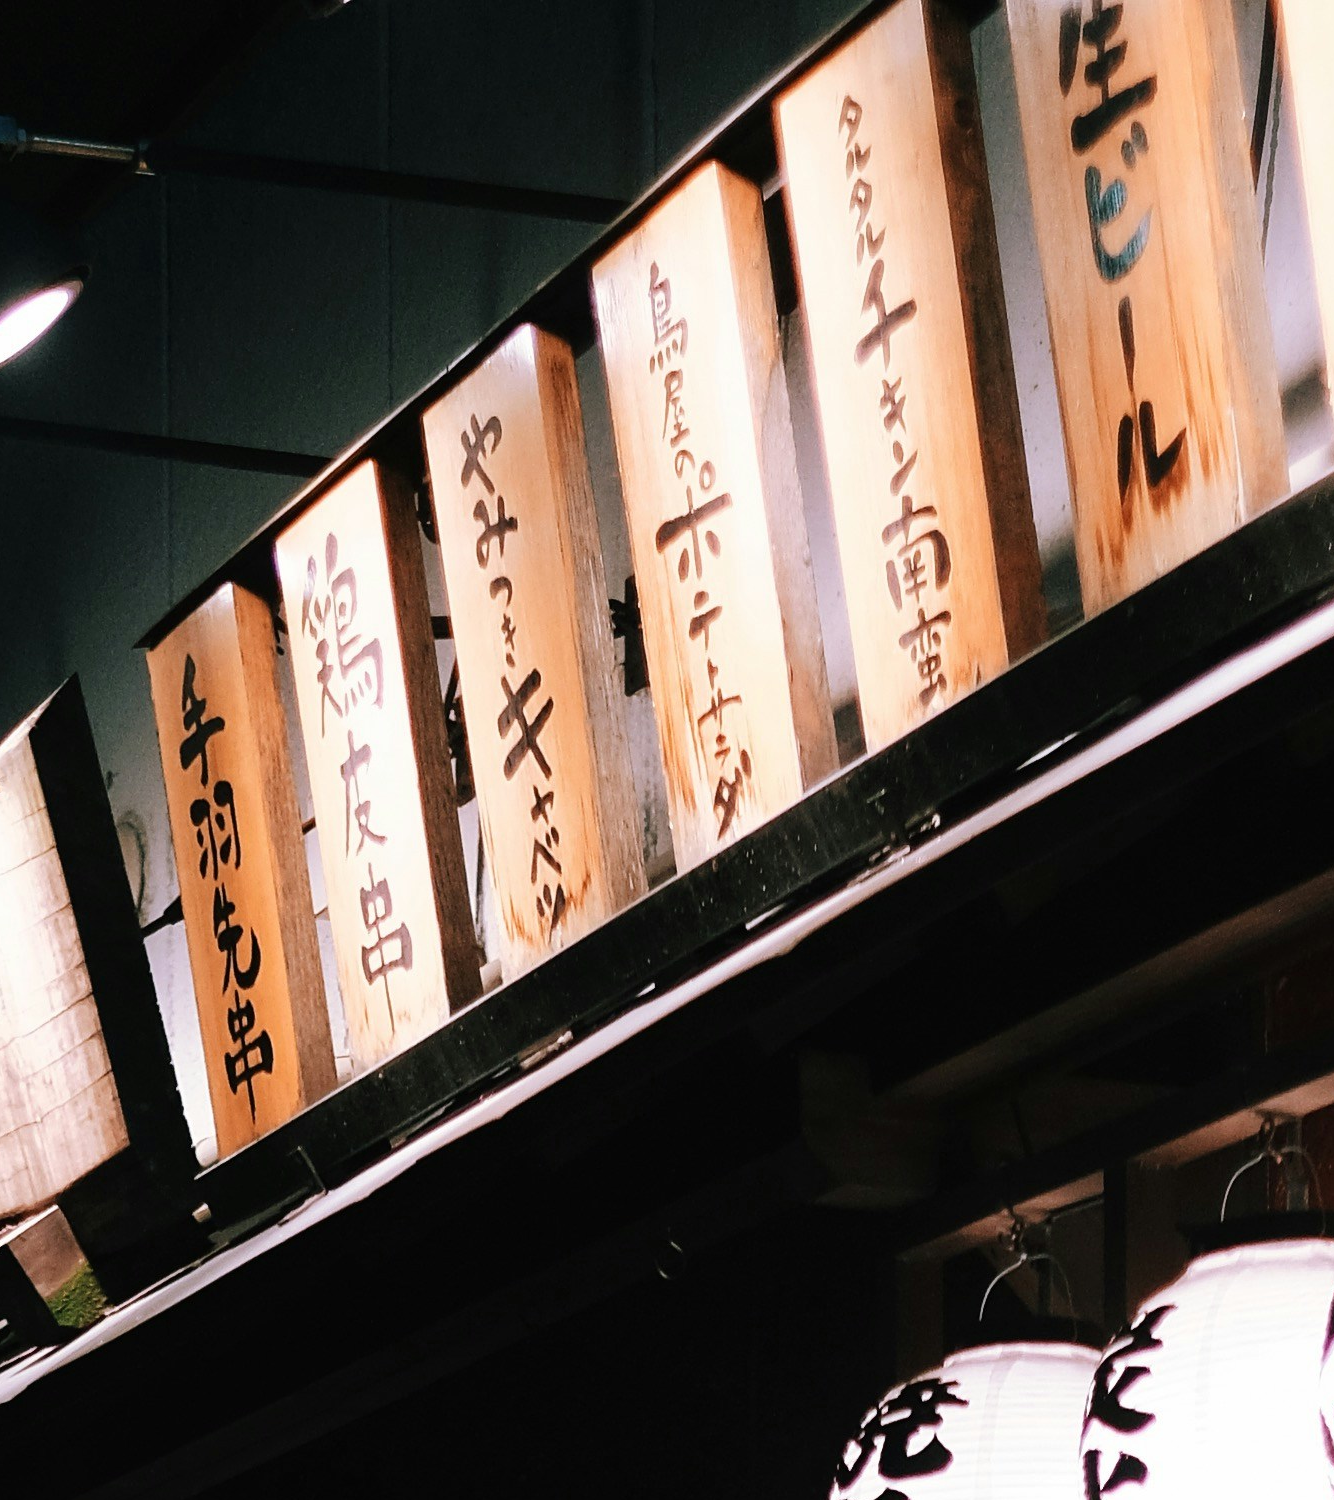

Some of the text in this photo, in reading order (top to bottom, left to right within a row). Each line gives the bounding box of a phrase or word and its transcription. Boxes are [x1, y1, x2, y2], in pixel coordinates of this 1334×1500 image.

[647, 260, 752, 841] 鳥屋のポテトサラダ
[838, 93, 952, 708] タルタルチキン南蛮
[178, 653, 275, 1125] 手羽先串
[302, 530, 414, 1036] 鶏皮串
[460, 412, 567, 942] やみつきキャベツ
